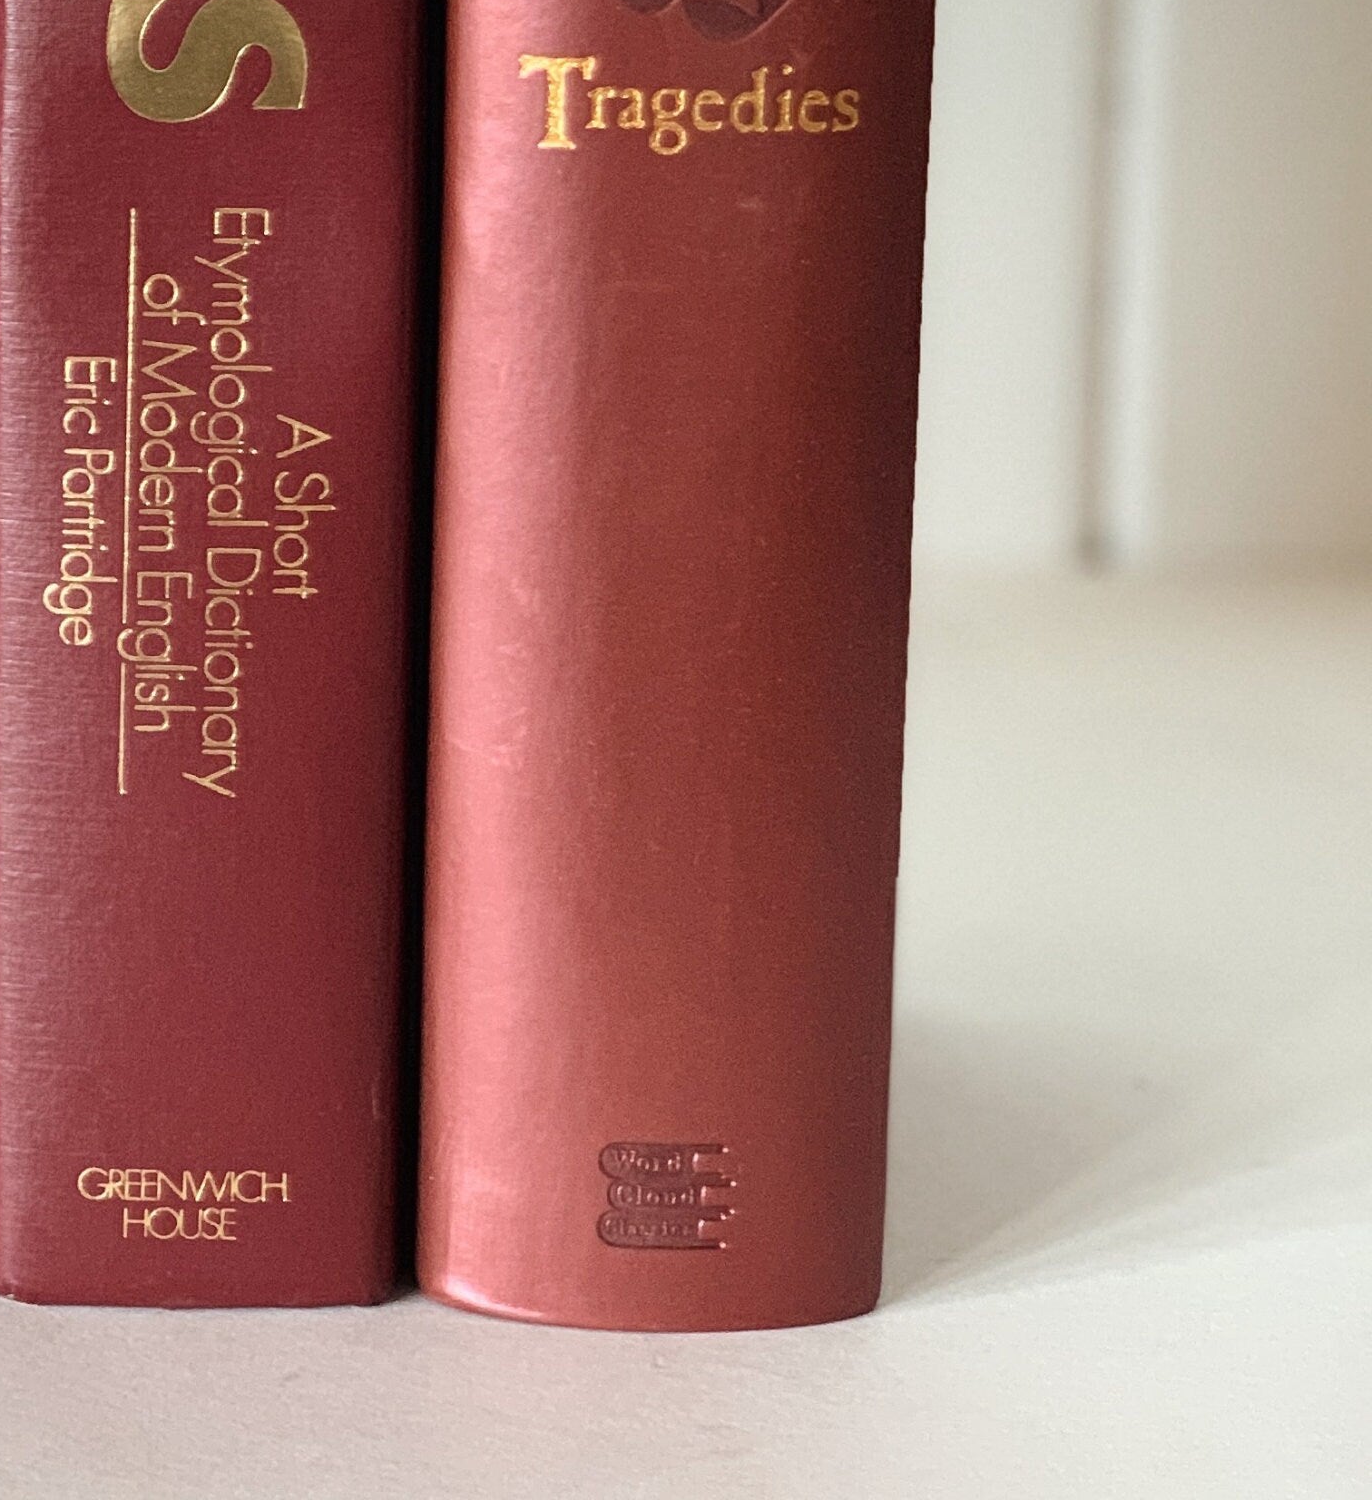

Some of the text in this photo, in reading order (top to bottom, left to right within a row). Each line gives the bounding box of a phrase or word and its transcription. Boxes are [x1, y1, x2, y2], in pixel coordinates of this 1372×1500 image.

[519, 55, 860, 155] Tragedies
[42, 357, 118, 646] Eric Partridge
[117, 273, 206, 731] of Modern English
[182, 206, 272, 797] Etymological Dictionary
[273, 415, 336, 599] A Short
[78, 1167, 290, 1202] GREENWICH
[613, 1149, 683, 1173] Word
[615, 1184, 696, 1206] Cloud
[123, 1209, 238, 1241] HOUSE
